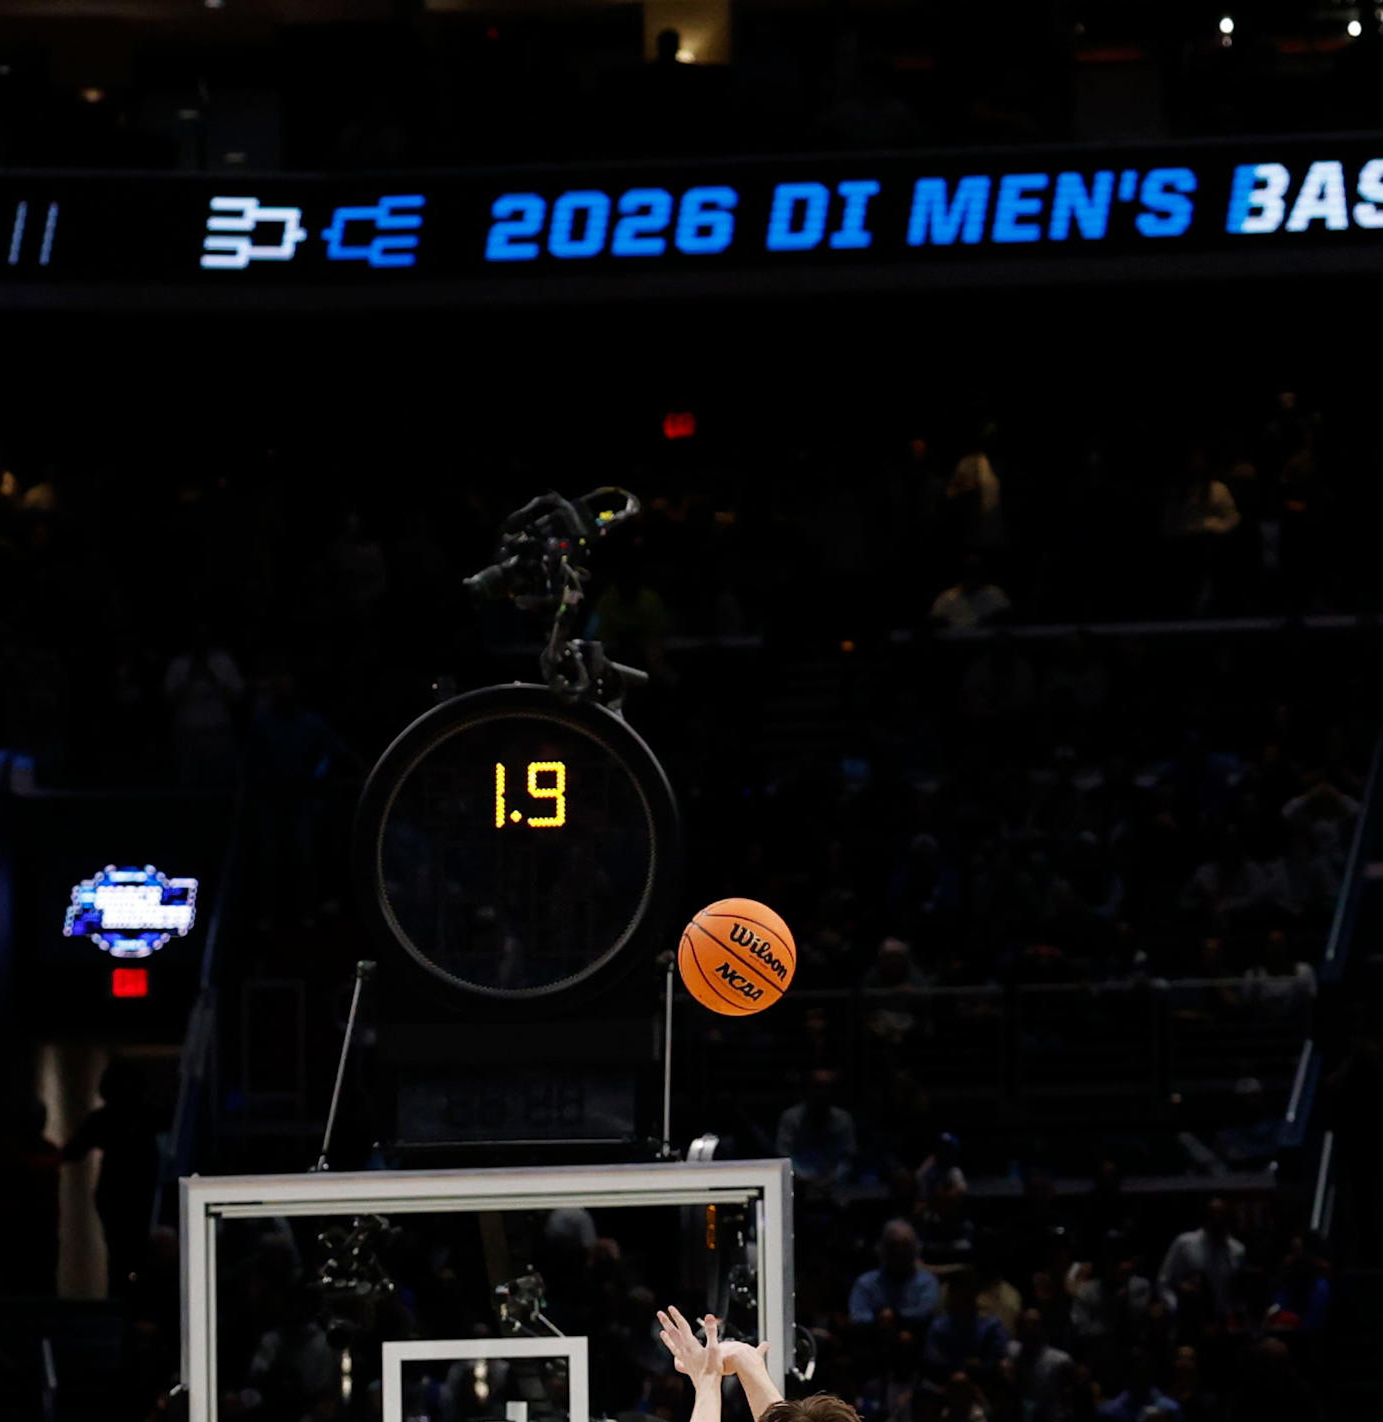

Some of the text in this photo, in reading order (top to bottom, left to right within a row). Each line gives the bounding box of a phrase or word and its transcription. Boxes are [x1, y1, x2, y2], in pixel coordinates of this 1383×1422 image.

[485, 186, 738, 260] 2026
[767, 181, 880, 250] DI
[907, 168, 1197, 245] MEN'S
[496, 762, 565, 828] 1.9
[715, 962, 764, 1001] NCAA
[729, 922, 788, 982] Wilson
